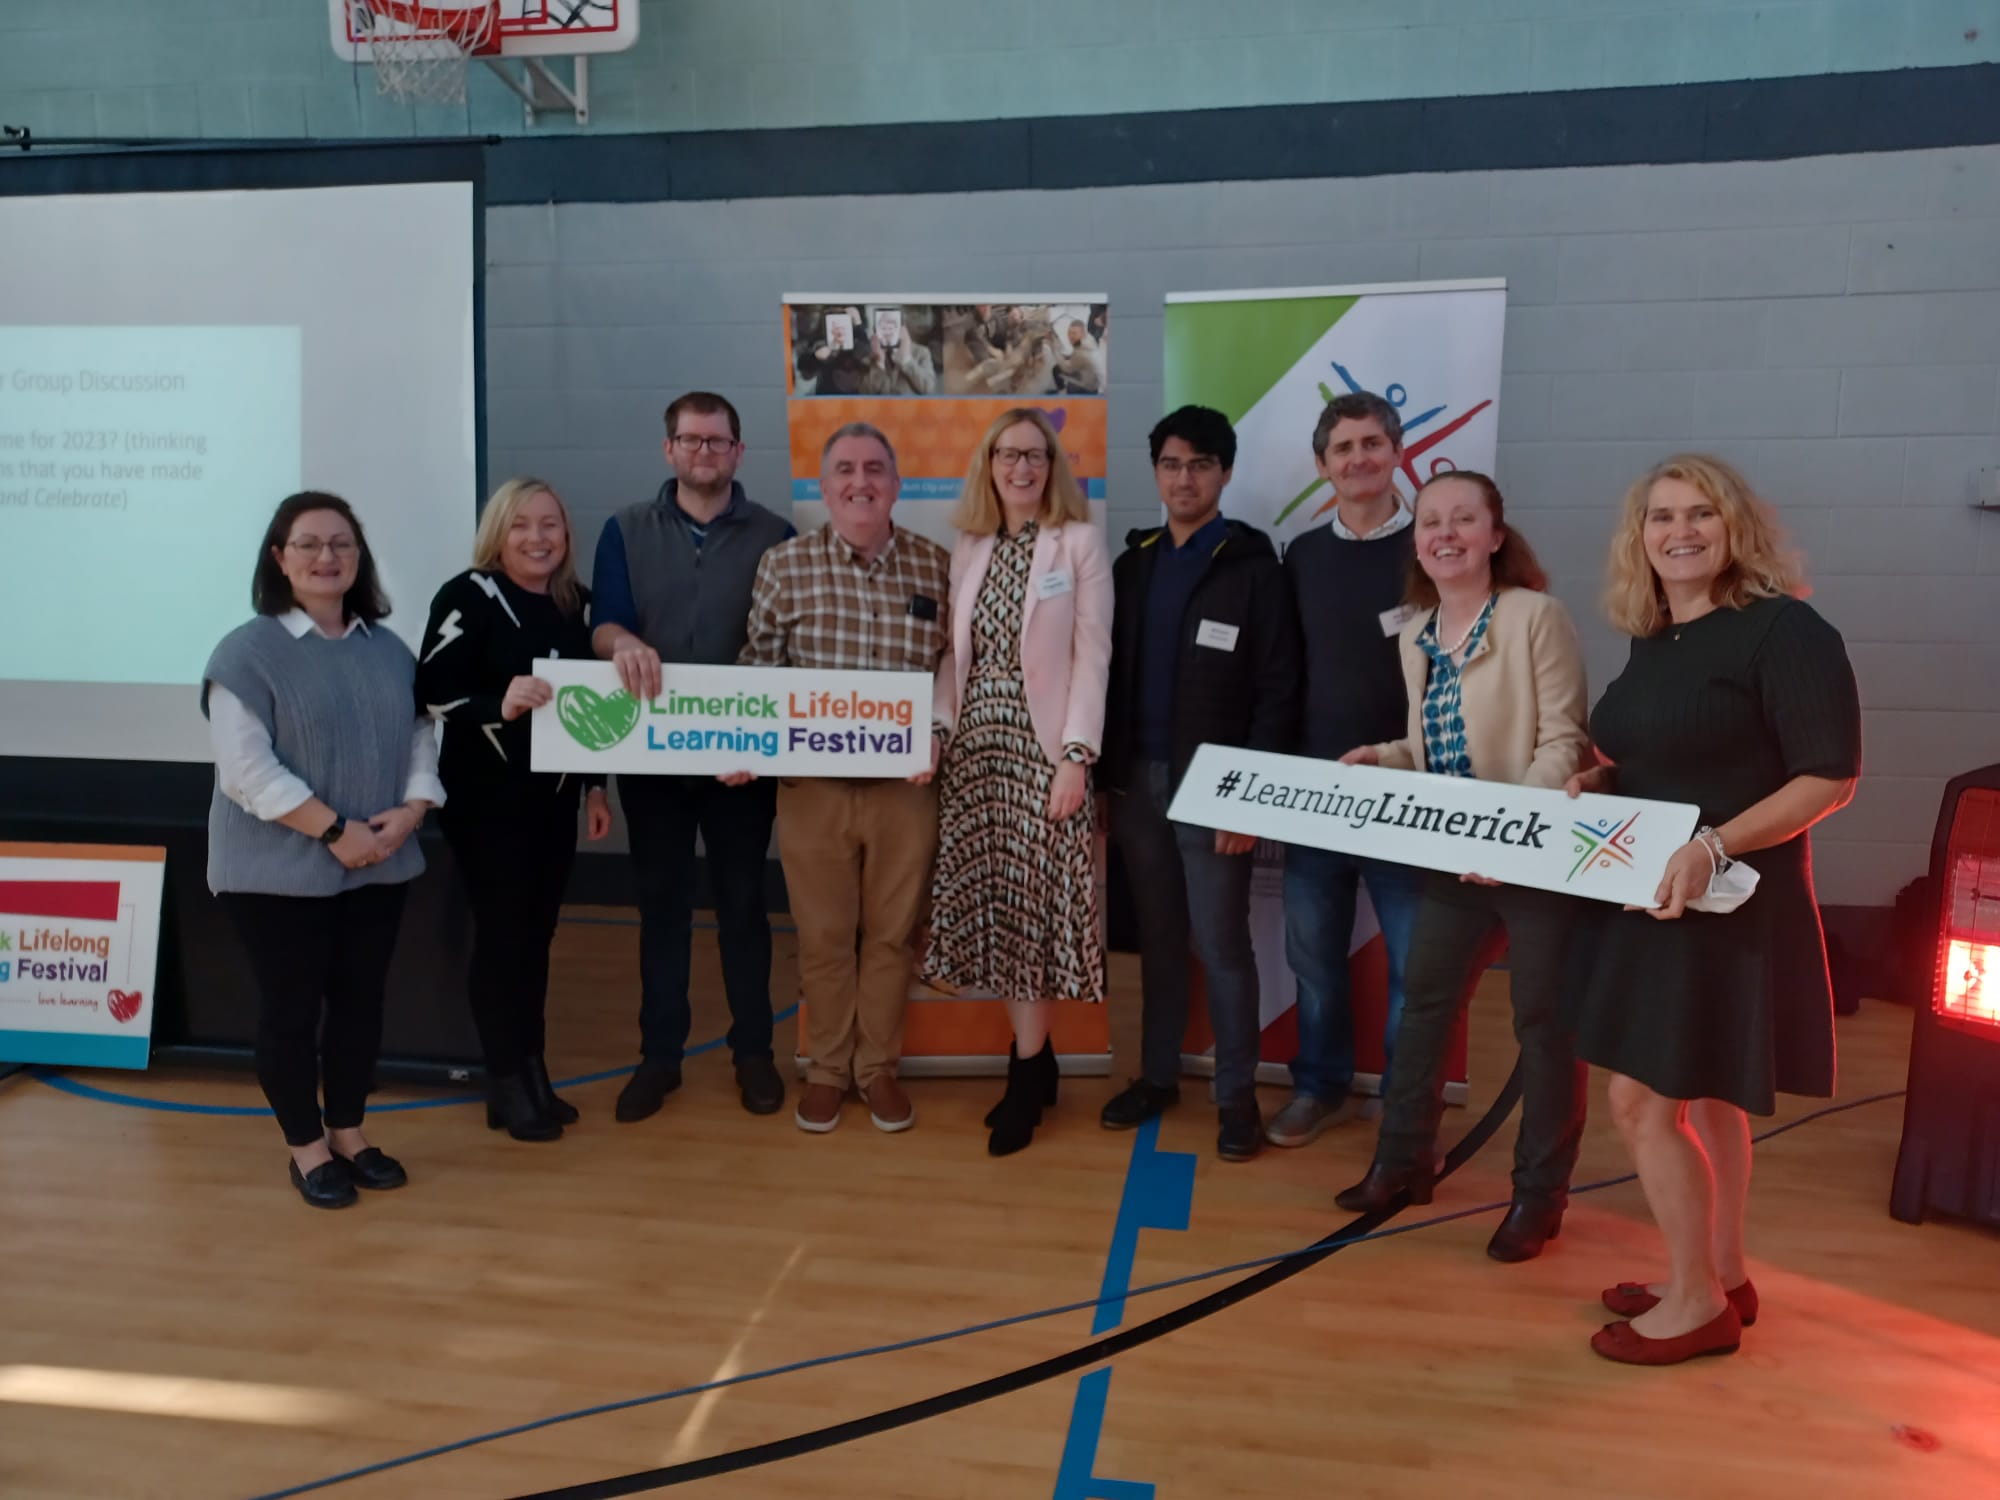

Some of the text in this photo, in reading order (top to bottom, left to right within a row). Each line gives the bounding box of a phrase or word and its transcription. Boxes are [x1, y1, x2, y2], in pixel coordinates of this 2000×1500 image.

[11, 368, 73, 395] Group
[79, 369, 185, 392] Discussion
[31, 429, 55, 449] for
[61, 430, 118, 449] 2023?
[124, 431, 207, 455] (thinking
[19, 458, 56, 479] that
[61, 463, 94, 482] you
[100, 459, 145, 480] have
[151, 460, 203, 480] made
[34, 488, 128, 511] Celebrate)
[648, 690, 913, 725] Limerick Lifelong
[647, 725, 912, 757] Learning Festival
[1215, 769, 1552, 849] #LearningLimerick
[19, 928, 110, 958] Lifelong
[18, 957, 108, 983] Festival
[60, 992, 99, 1012] learning
